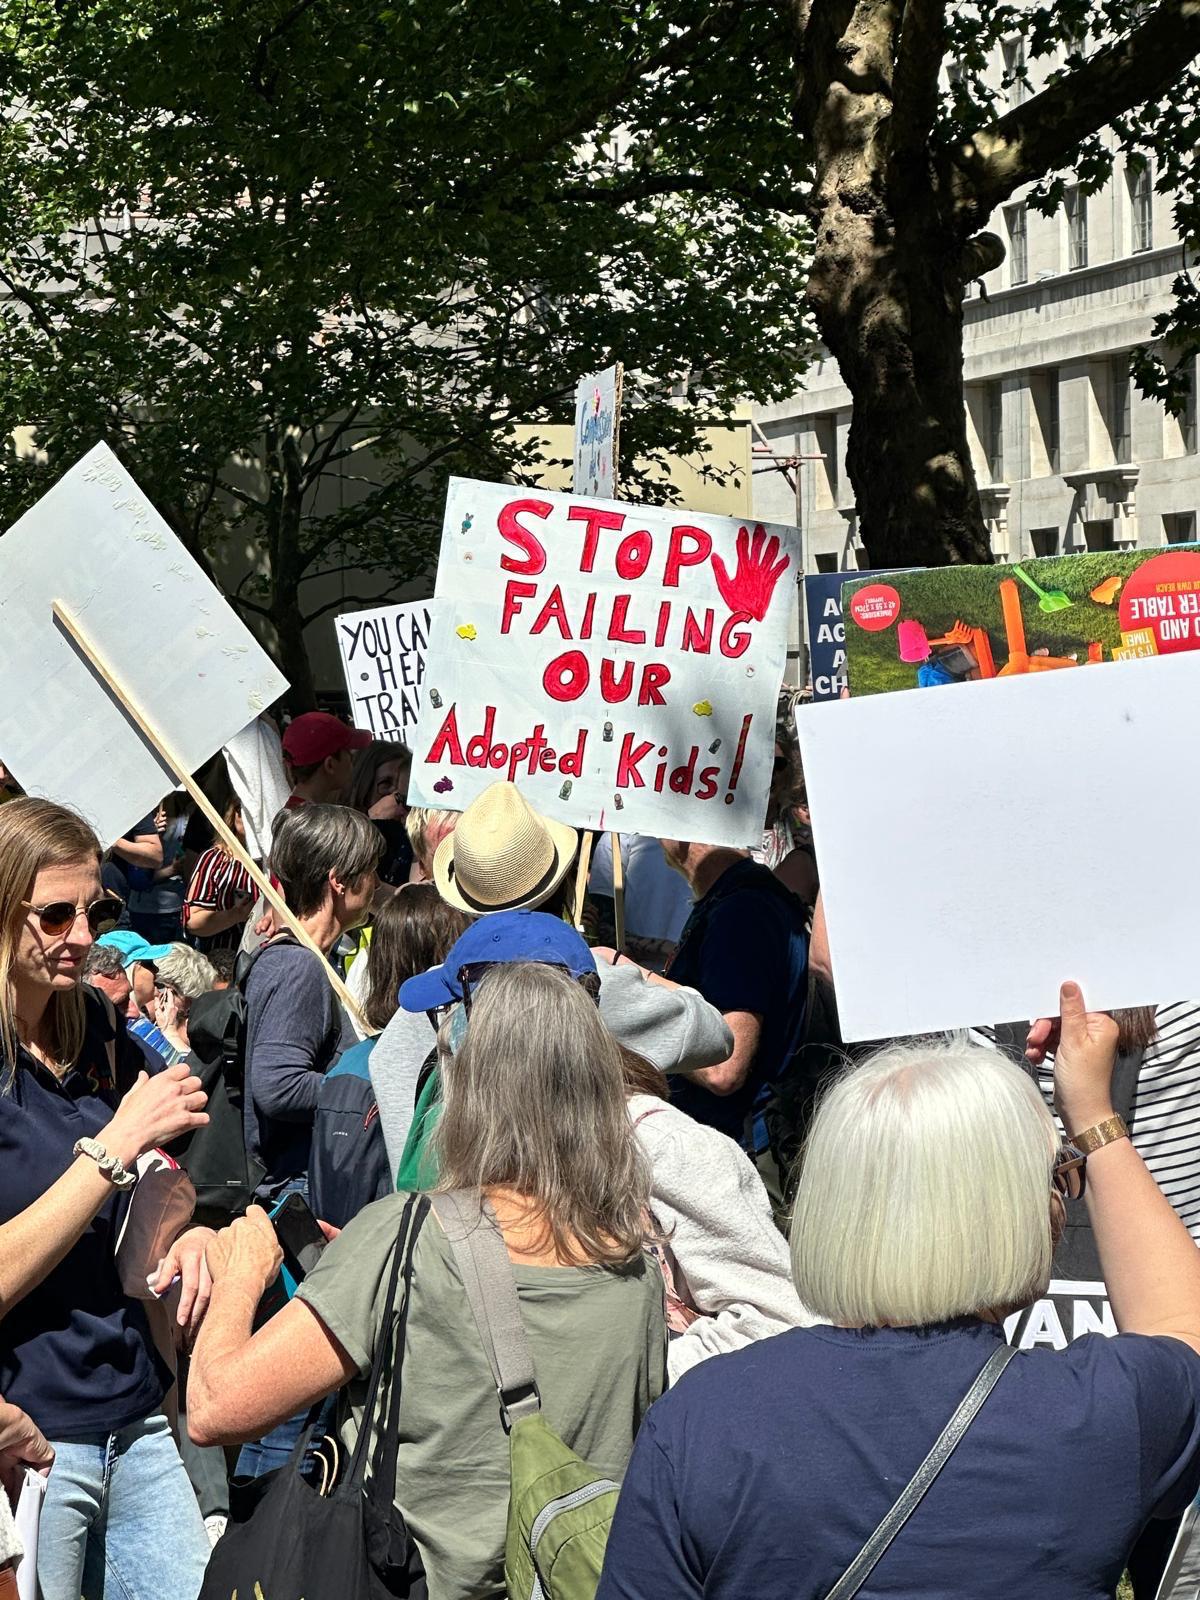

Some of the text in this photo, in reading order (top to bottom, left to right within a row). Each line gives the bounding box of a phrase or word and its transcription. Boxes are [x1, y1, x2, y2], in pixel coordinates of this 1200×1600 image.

[497, 499, 712, 587] STOP
[1129, 593, 1200, 619] ER TABLE
[1156, 582, 1176, 593] REACH
[341, 617, 391, 661] YOU
[501, 580, 752, 659] FAILING
[1160, 617, 1190, 640] AND
[542, 650, 671, 706] OUR
[425, 702, 753, 805] Adopted Kids!
